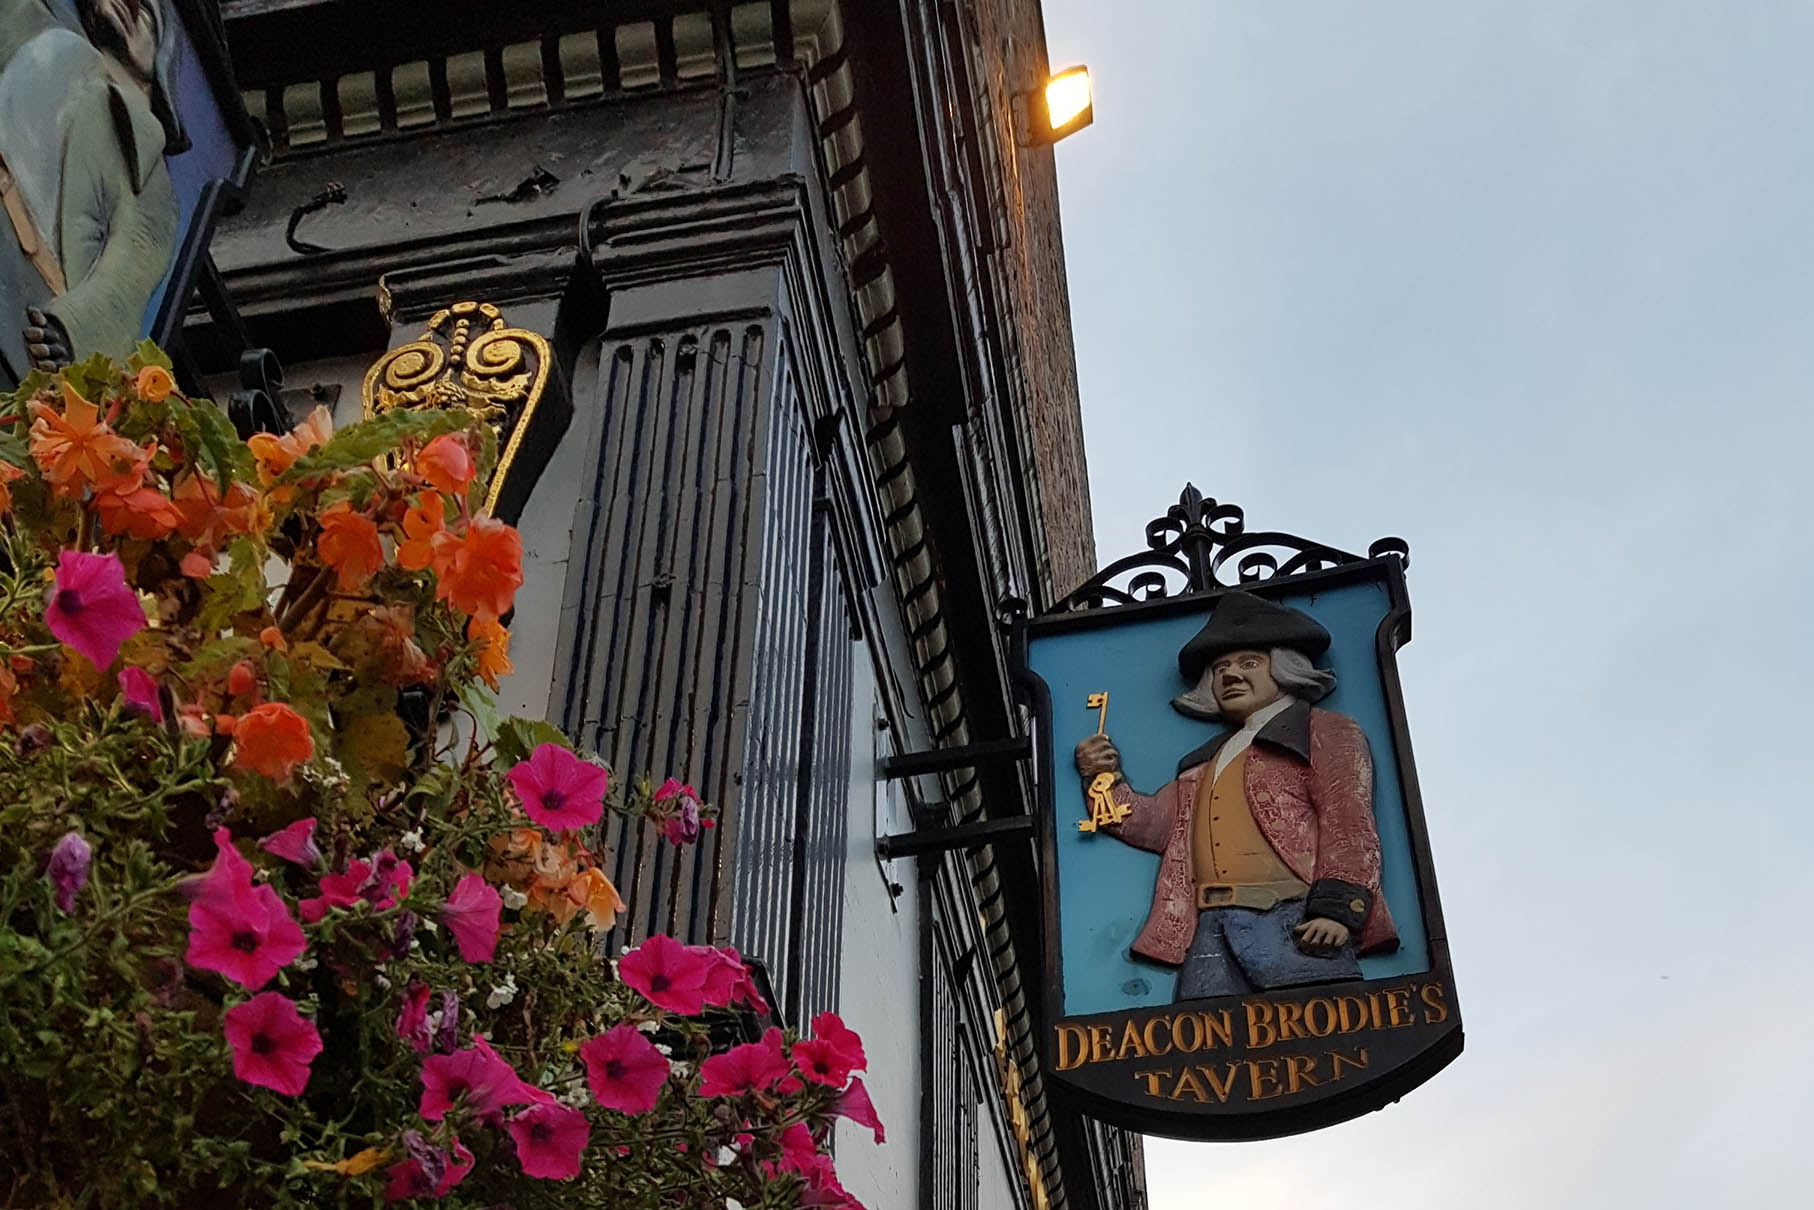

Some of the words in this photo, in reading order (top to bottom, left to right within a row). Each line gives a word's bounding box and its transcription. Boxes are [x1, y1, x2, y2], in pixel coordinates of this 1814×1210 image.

[1055, 1008, 1234, 1071] DEACON
[1241, 983, 1448, 1048] BRODIE'S
[1134, 1047, 1369, 1103] TAVERN
